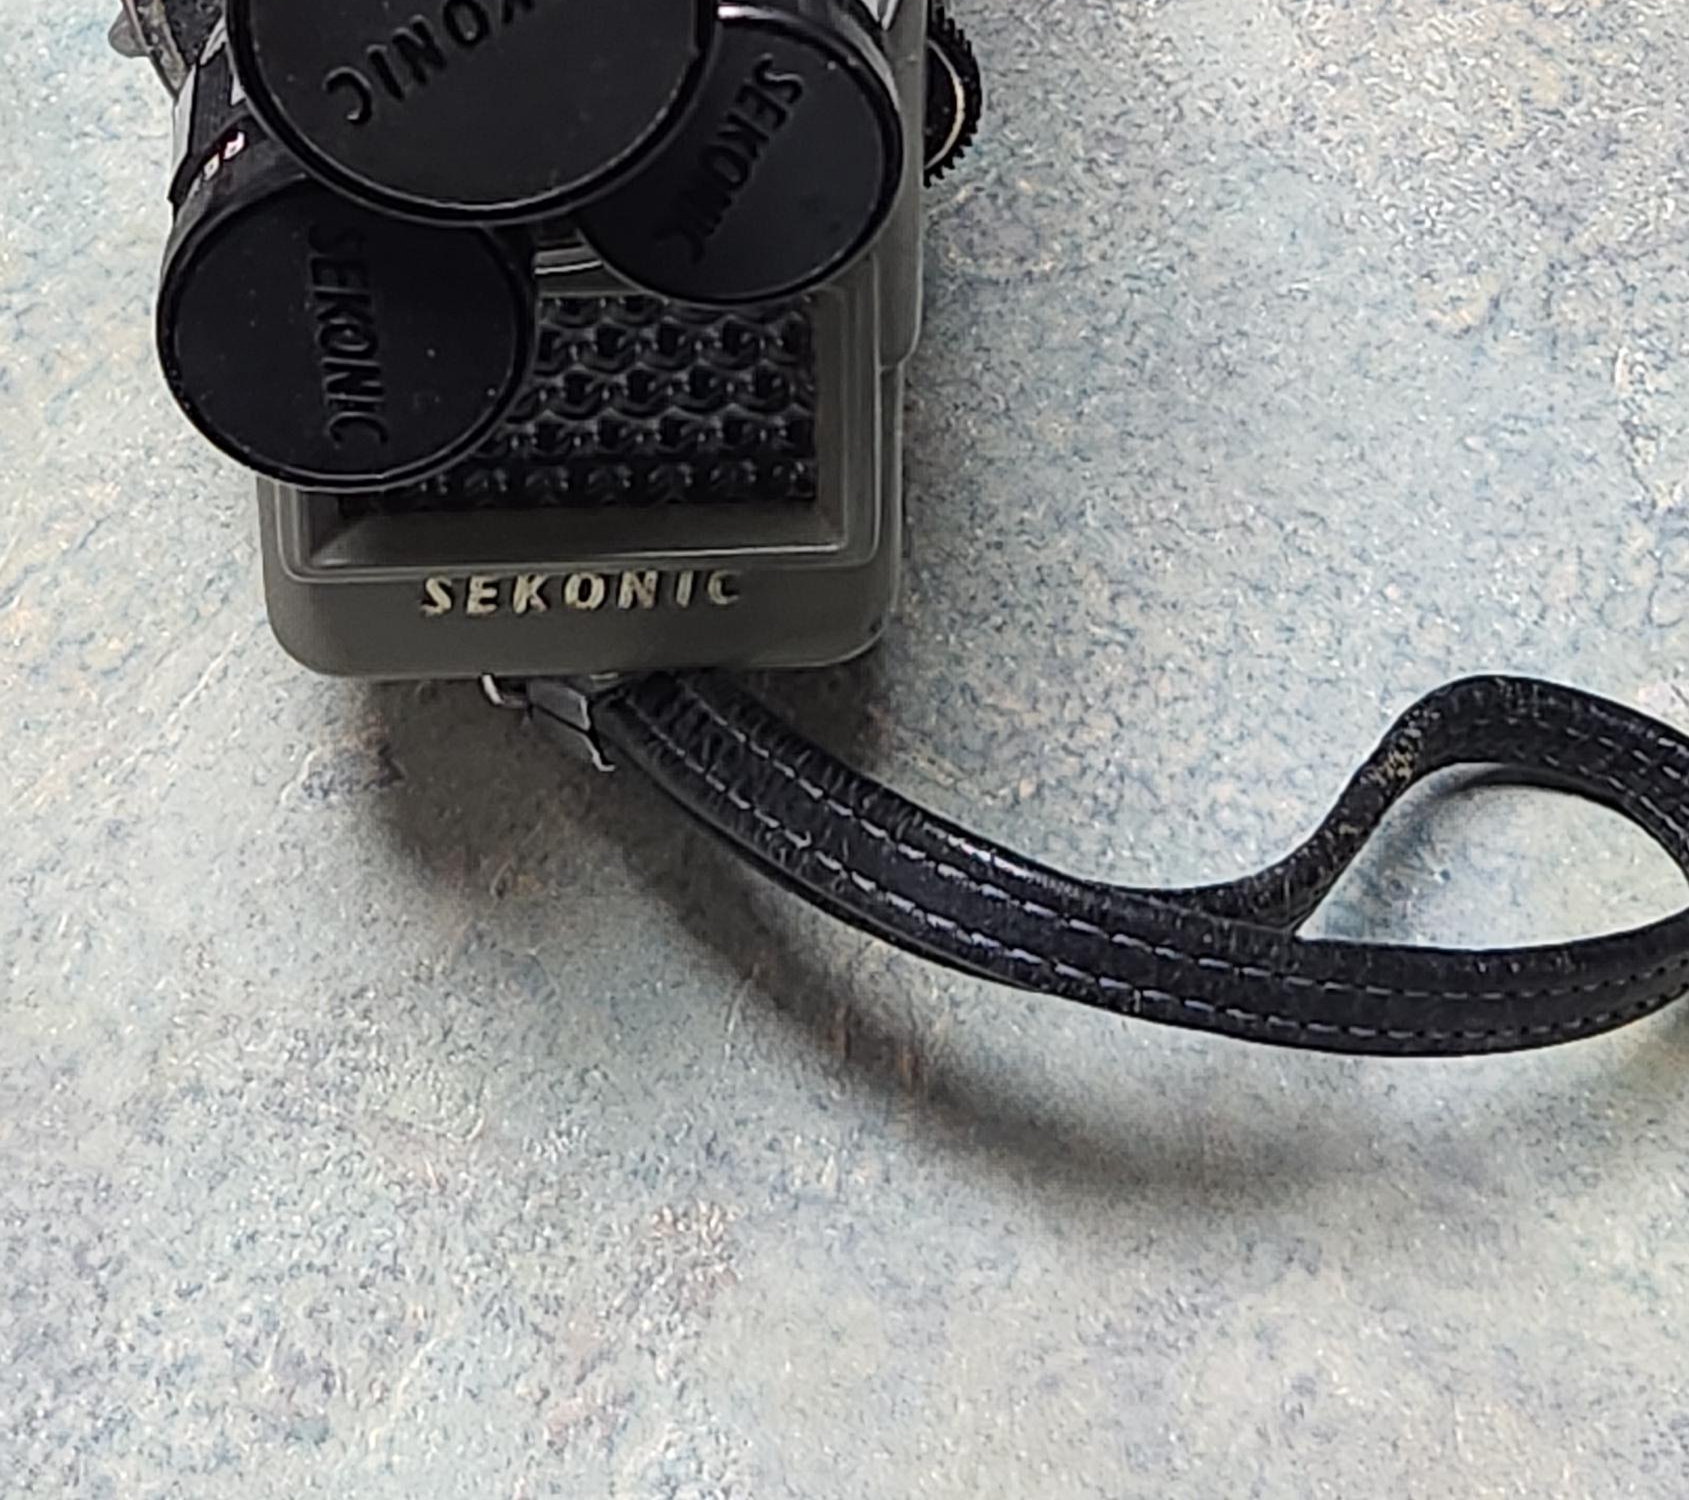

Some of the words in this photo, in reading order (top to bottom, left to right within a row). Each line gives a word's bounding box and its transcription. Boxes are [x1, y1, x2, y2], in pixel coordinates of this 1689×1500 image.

[654, 53, 804, 266] SEKONIC
[307, 221, 389, 445] SEKONIC
[420, 570, 743, 617] SEKONIC
